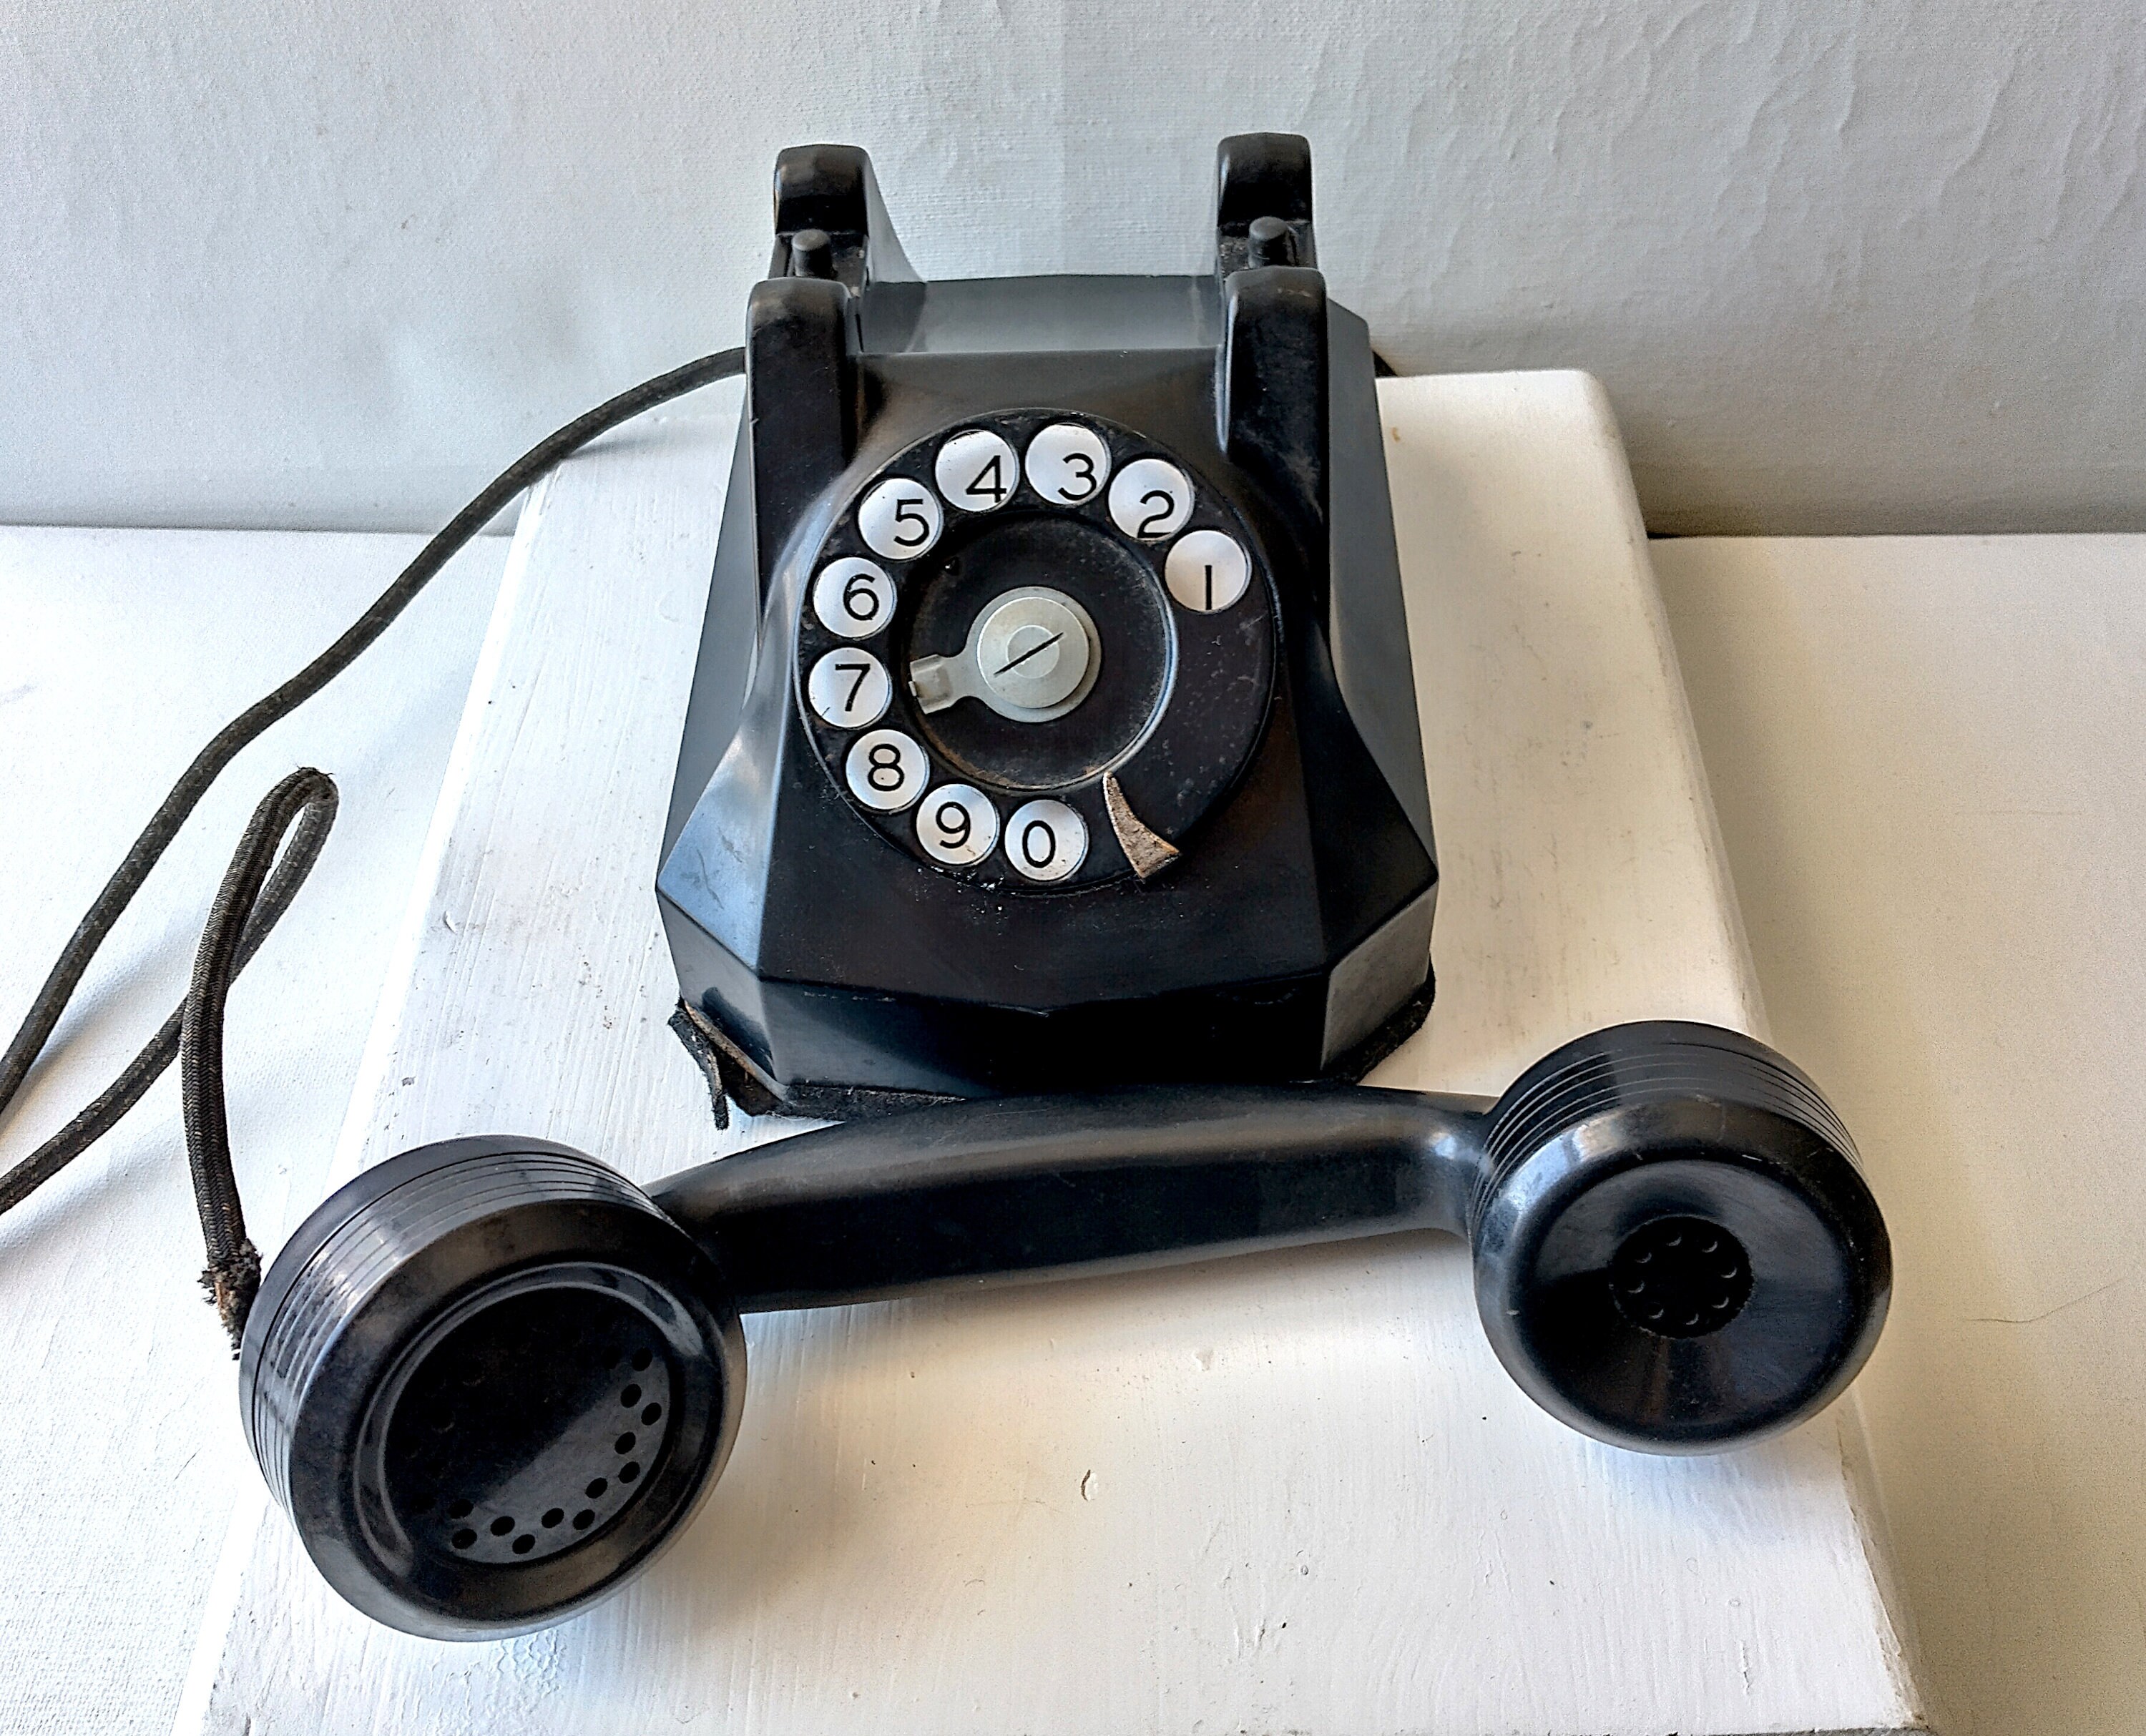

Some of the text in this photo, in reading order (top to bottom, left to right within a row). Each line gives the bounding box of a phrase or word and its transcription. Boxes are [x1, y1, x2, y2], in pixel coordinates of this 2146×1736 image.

[966, 456, 1006, 502] 4
[1058, 453, 1097, 500] 3
[893, 499, 930, 546] 5
[1137, 490, 1175, 538] 2
[843, 574, 879, 621] 6
[1204, 564, 1212, 610] 1
[835, 663, 871, 712] 7
[867, 744, 904, 791] 8
[936, 802, 971, 849] 9
[1021, 820, 1056, 868] 0
